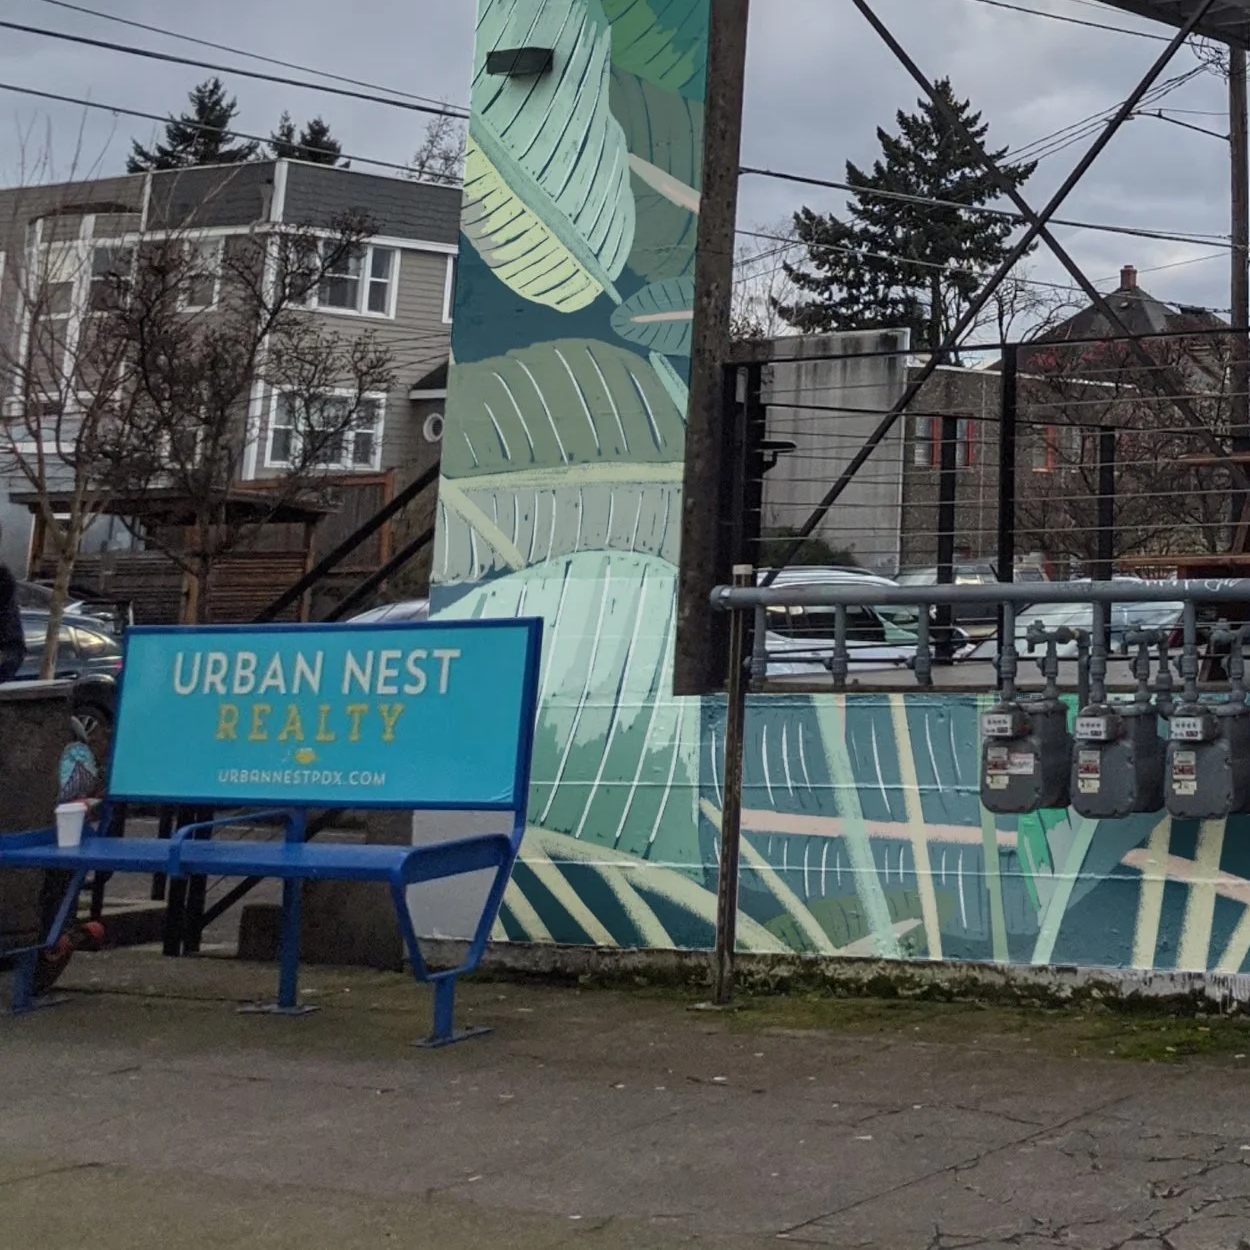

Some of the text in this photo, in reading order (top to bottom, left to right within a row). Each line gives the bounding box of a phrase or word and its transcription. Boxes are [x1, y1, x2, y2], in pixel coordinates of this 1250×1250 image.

[173, 649, 461, 695] URBAN NEST
[215, 703, 406, 742] REALTY
[217, 769, 387, 787] URBANNESTPDX.COM
